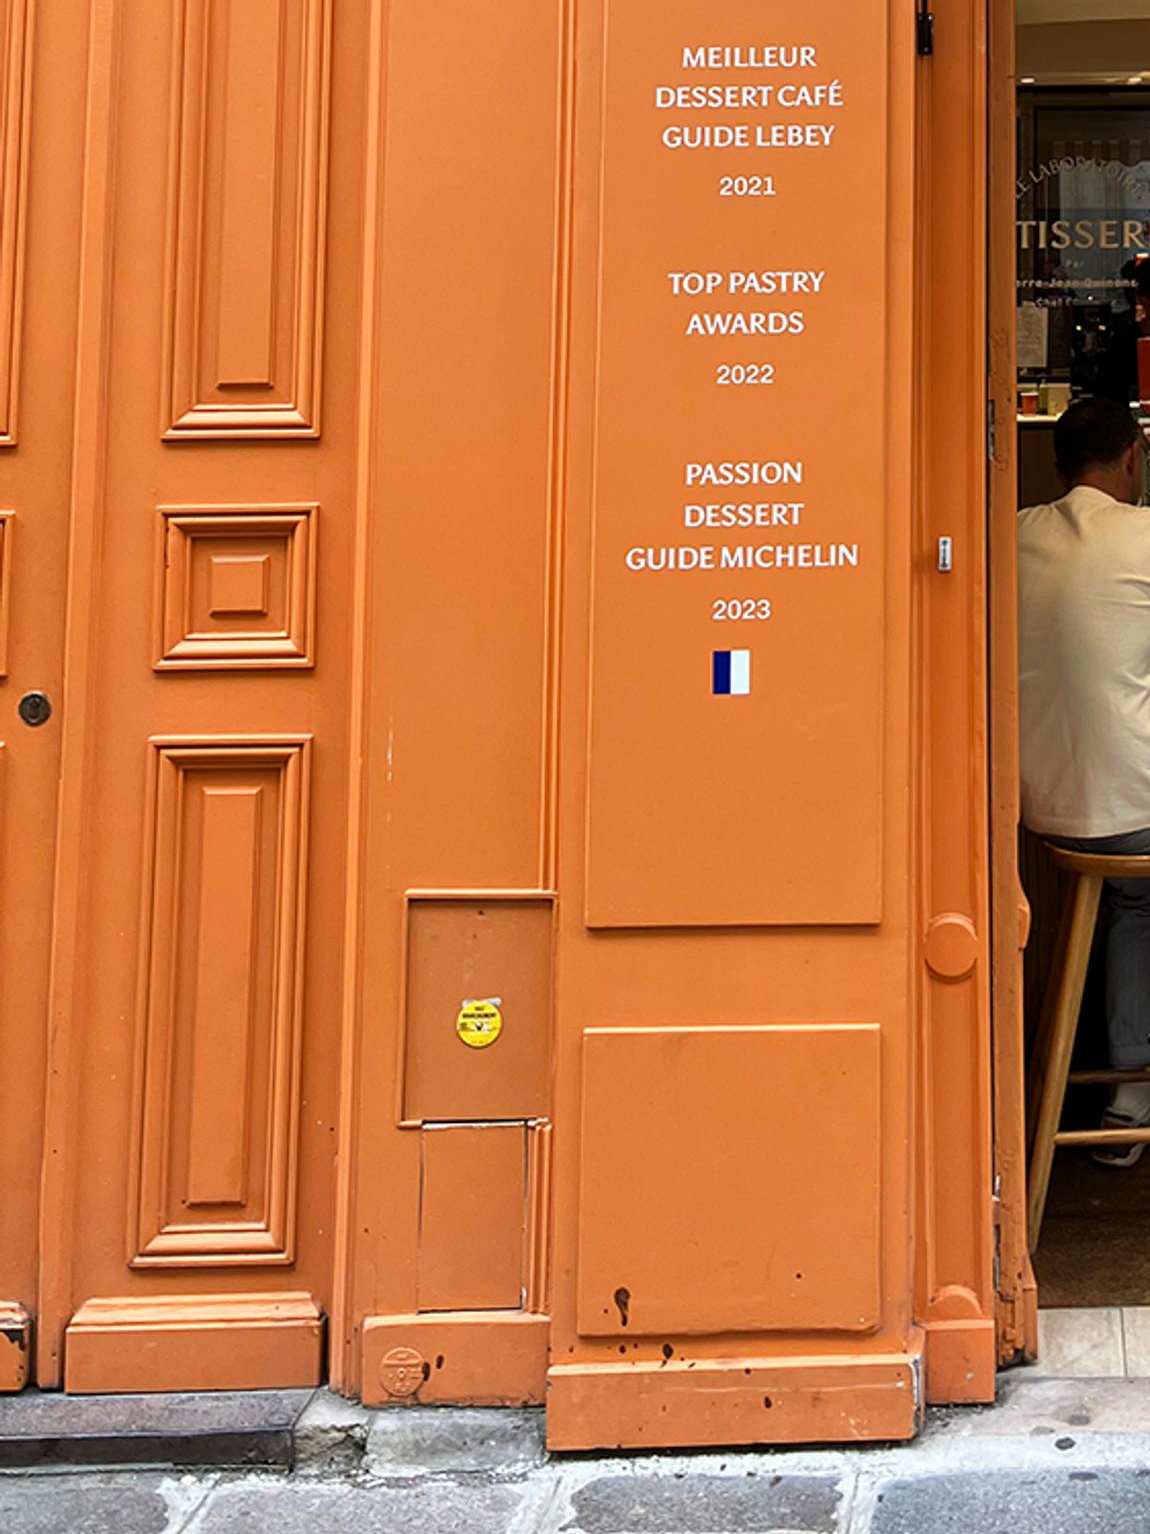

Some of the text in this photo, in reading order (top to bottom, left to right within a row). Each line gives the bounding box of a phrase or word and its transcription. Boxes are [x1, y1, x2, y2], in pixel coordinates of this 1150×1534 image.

[682, 45, 817, 69] MEILLEUR
[655, 79, 844, 109] DESSERT CAFÉ
[661, 124, 835, 149] GUIDE LEBEY
[719, 176, 776, 197] 2021
[667, 270, 825, 295] TOP PASTRY
[685, 311, 804, 336] AWARDS
[716, 363, 774, 385] 2022
[685, 461, 803, 486] PASSION
[684, 502, 805, 528] DESSERT
[625, 544, 859, 571] GUIDE MICHELIN
[712, 598, 771, 621] 2023
